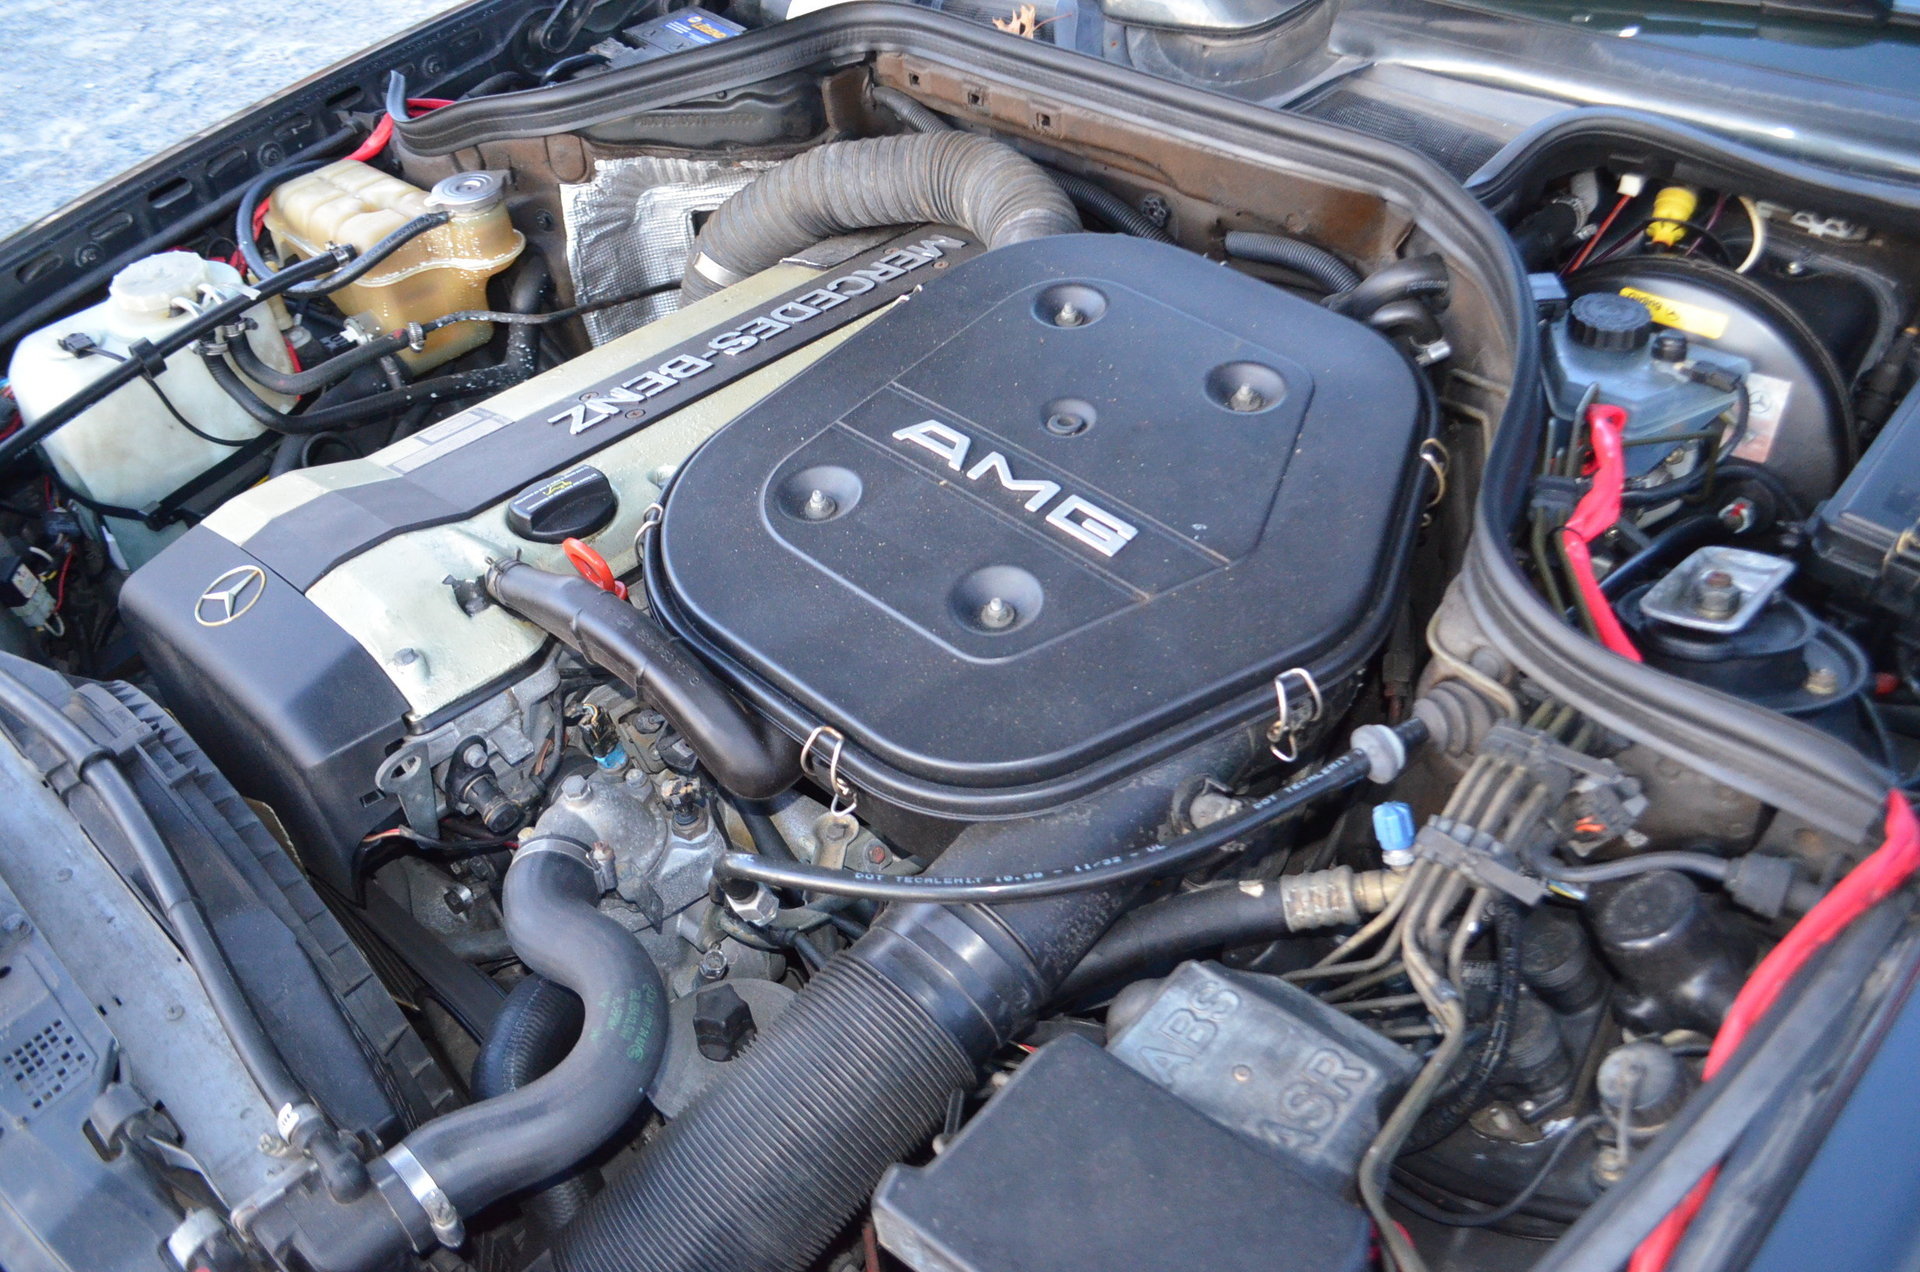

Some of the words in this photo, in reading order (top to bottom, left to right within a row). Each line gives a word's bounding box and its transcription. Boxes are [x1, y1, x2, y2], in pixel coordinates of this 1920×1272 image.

[547, 234, 968, 435] MERCEDES-BENZ
[892, 419, 1139, 557] AMG
[1140, 981, 1240, 1085] ABS
[1258, 1047, 1369, 1150] ASR
